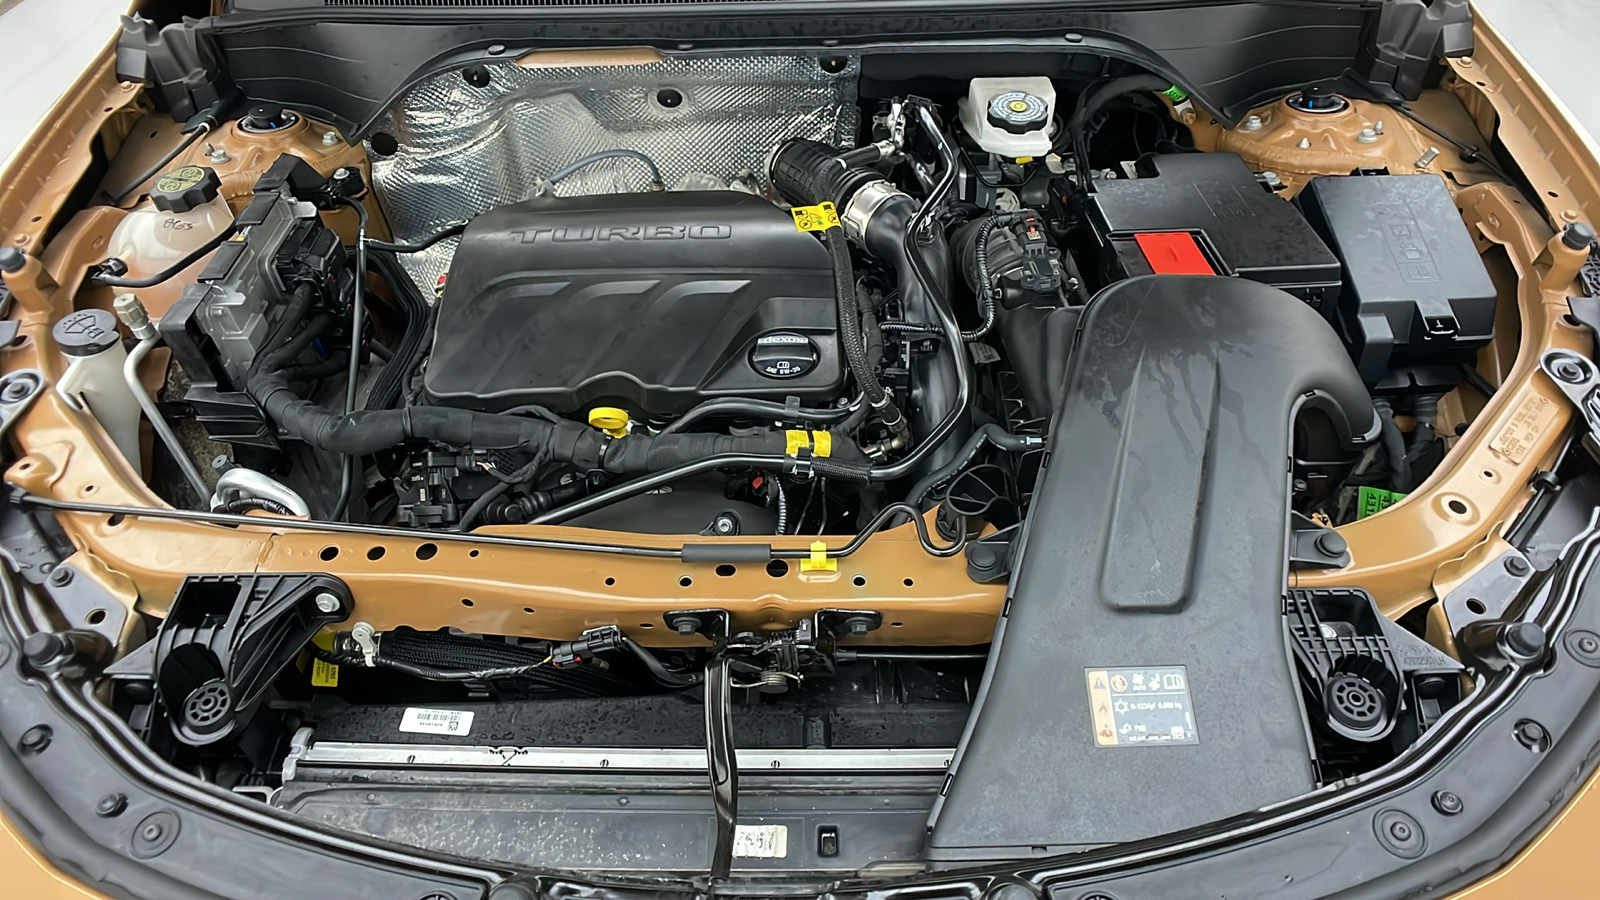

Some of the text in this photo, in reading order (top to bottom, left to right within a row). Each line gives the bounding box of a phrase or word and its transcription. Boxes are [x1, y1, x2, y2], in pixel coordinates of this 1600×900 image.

[509, 224, 732, 245] TURBO
[763, 336, 804, 344] dexos
[765, 366, 778, 375] SAE
